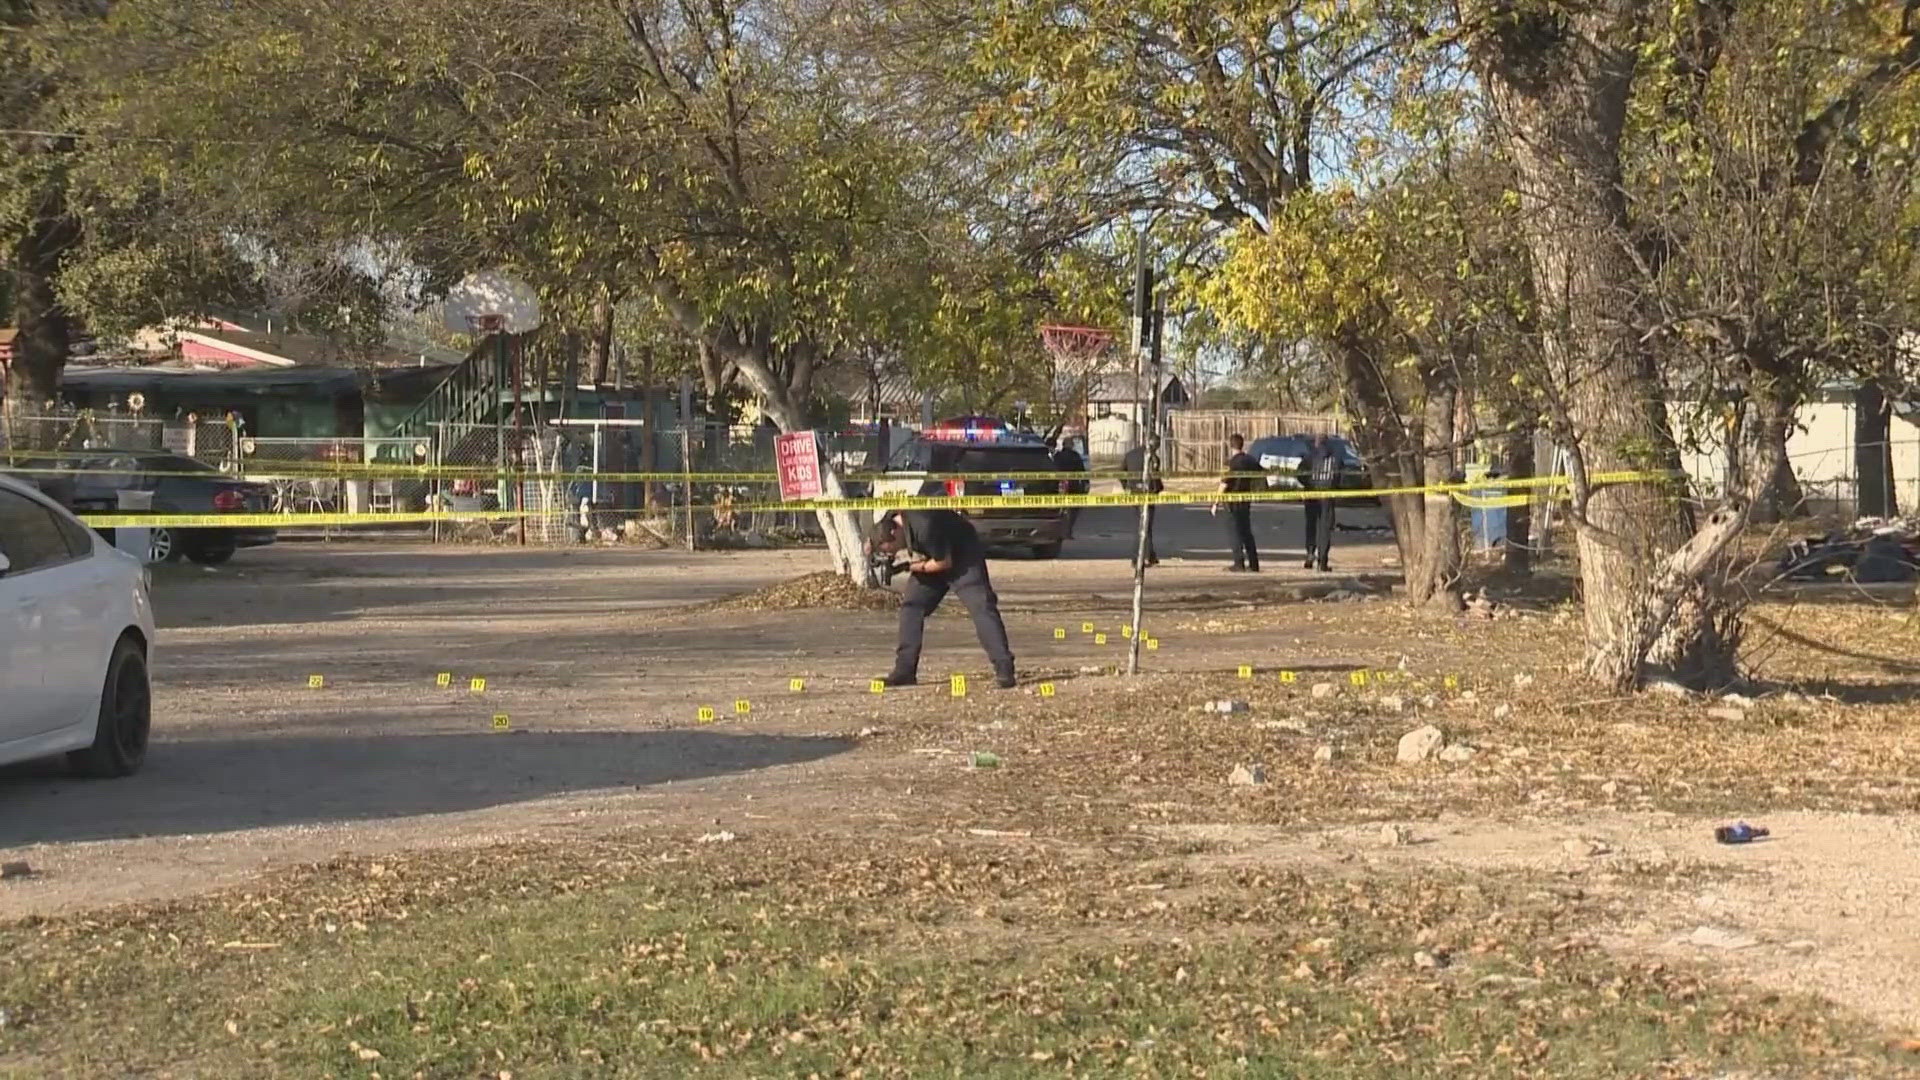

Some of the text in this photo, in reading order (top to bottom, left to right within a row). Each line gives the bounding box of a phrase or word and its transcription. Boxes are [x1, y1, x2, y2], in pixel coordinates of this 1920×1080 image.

[781, 438, 812, 456] DRIVE
[788, 465, 812, 482] KIDS
[474, 680, 484, 689] 17
[496, 717, 508, 727] 20
